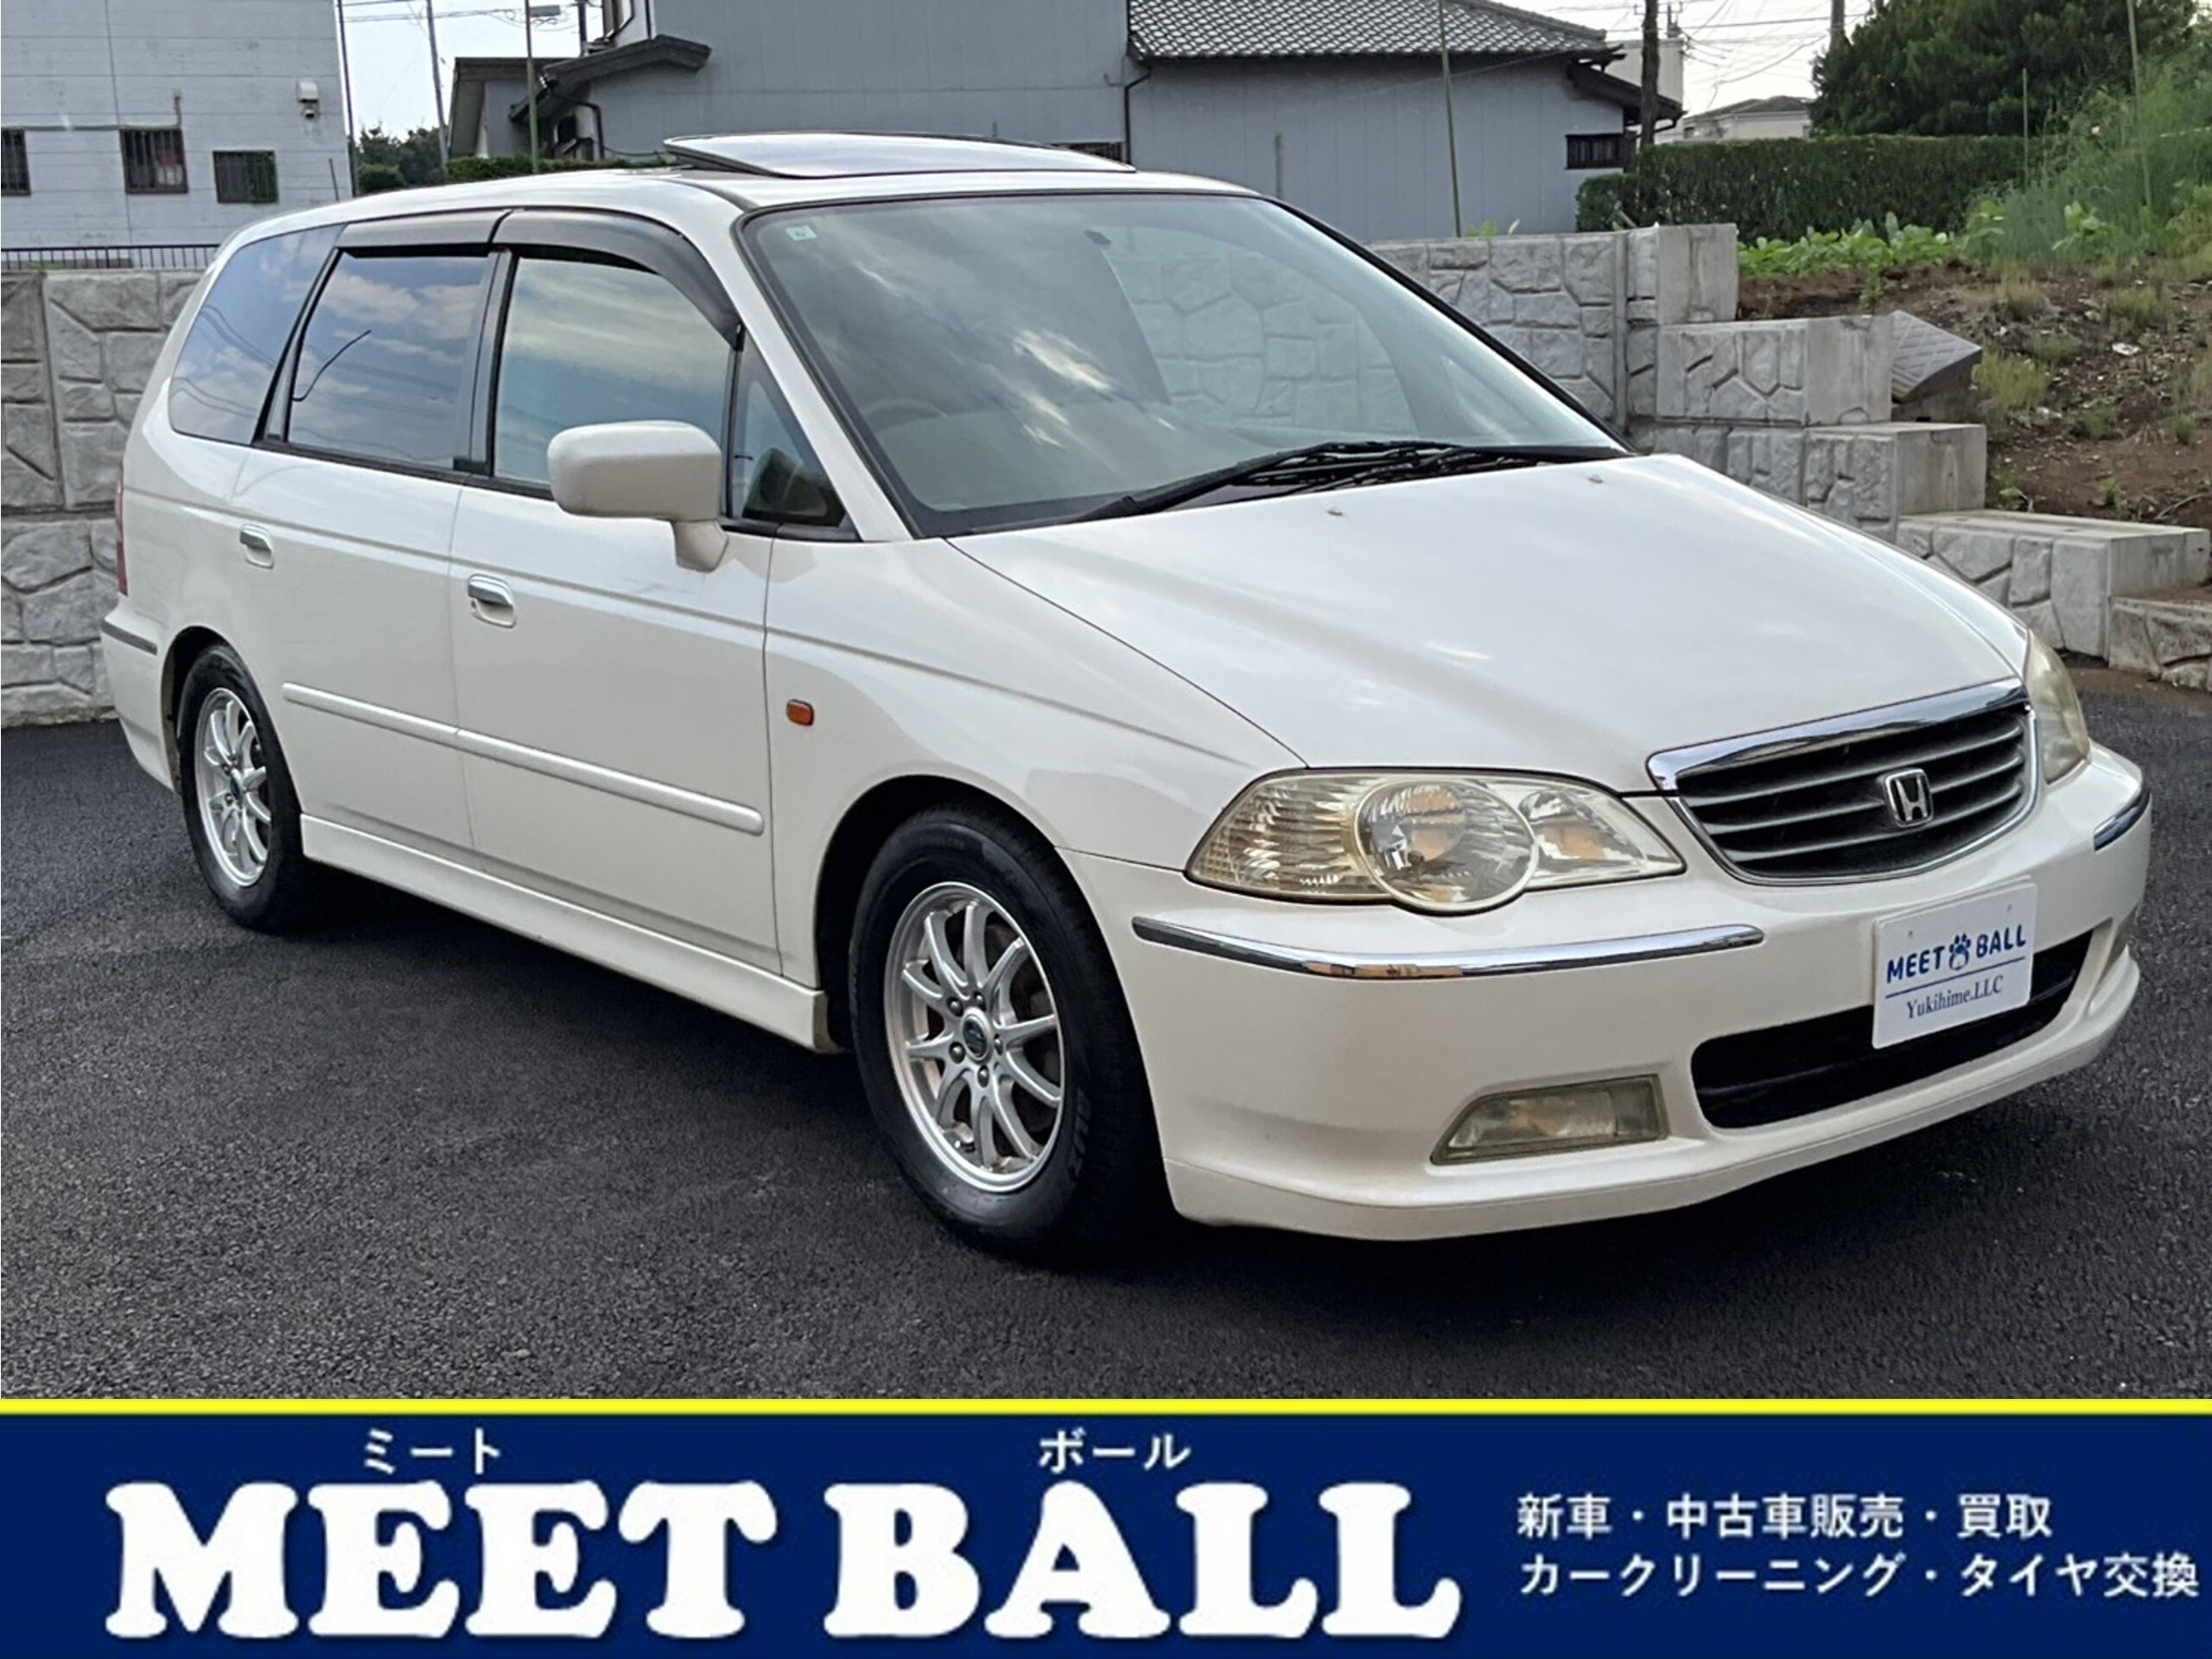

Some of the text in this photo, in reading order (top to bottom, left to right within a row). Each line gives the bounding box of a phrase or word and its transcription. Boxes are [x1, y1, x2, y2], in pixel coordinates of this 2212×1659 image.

[1886, 924, 2026, 983] MEET BALL
[1906, 975, 2004, 1019] Yukihime.LLC
